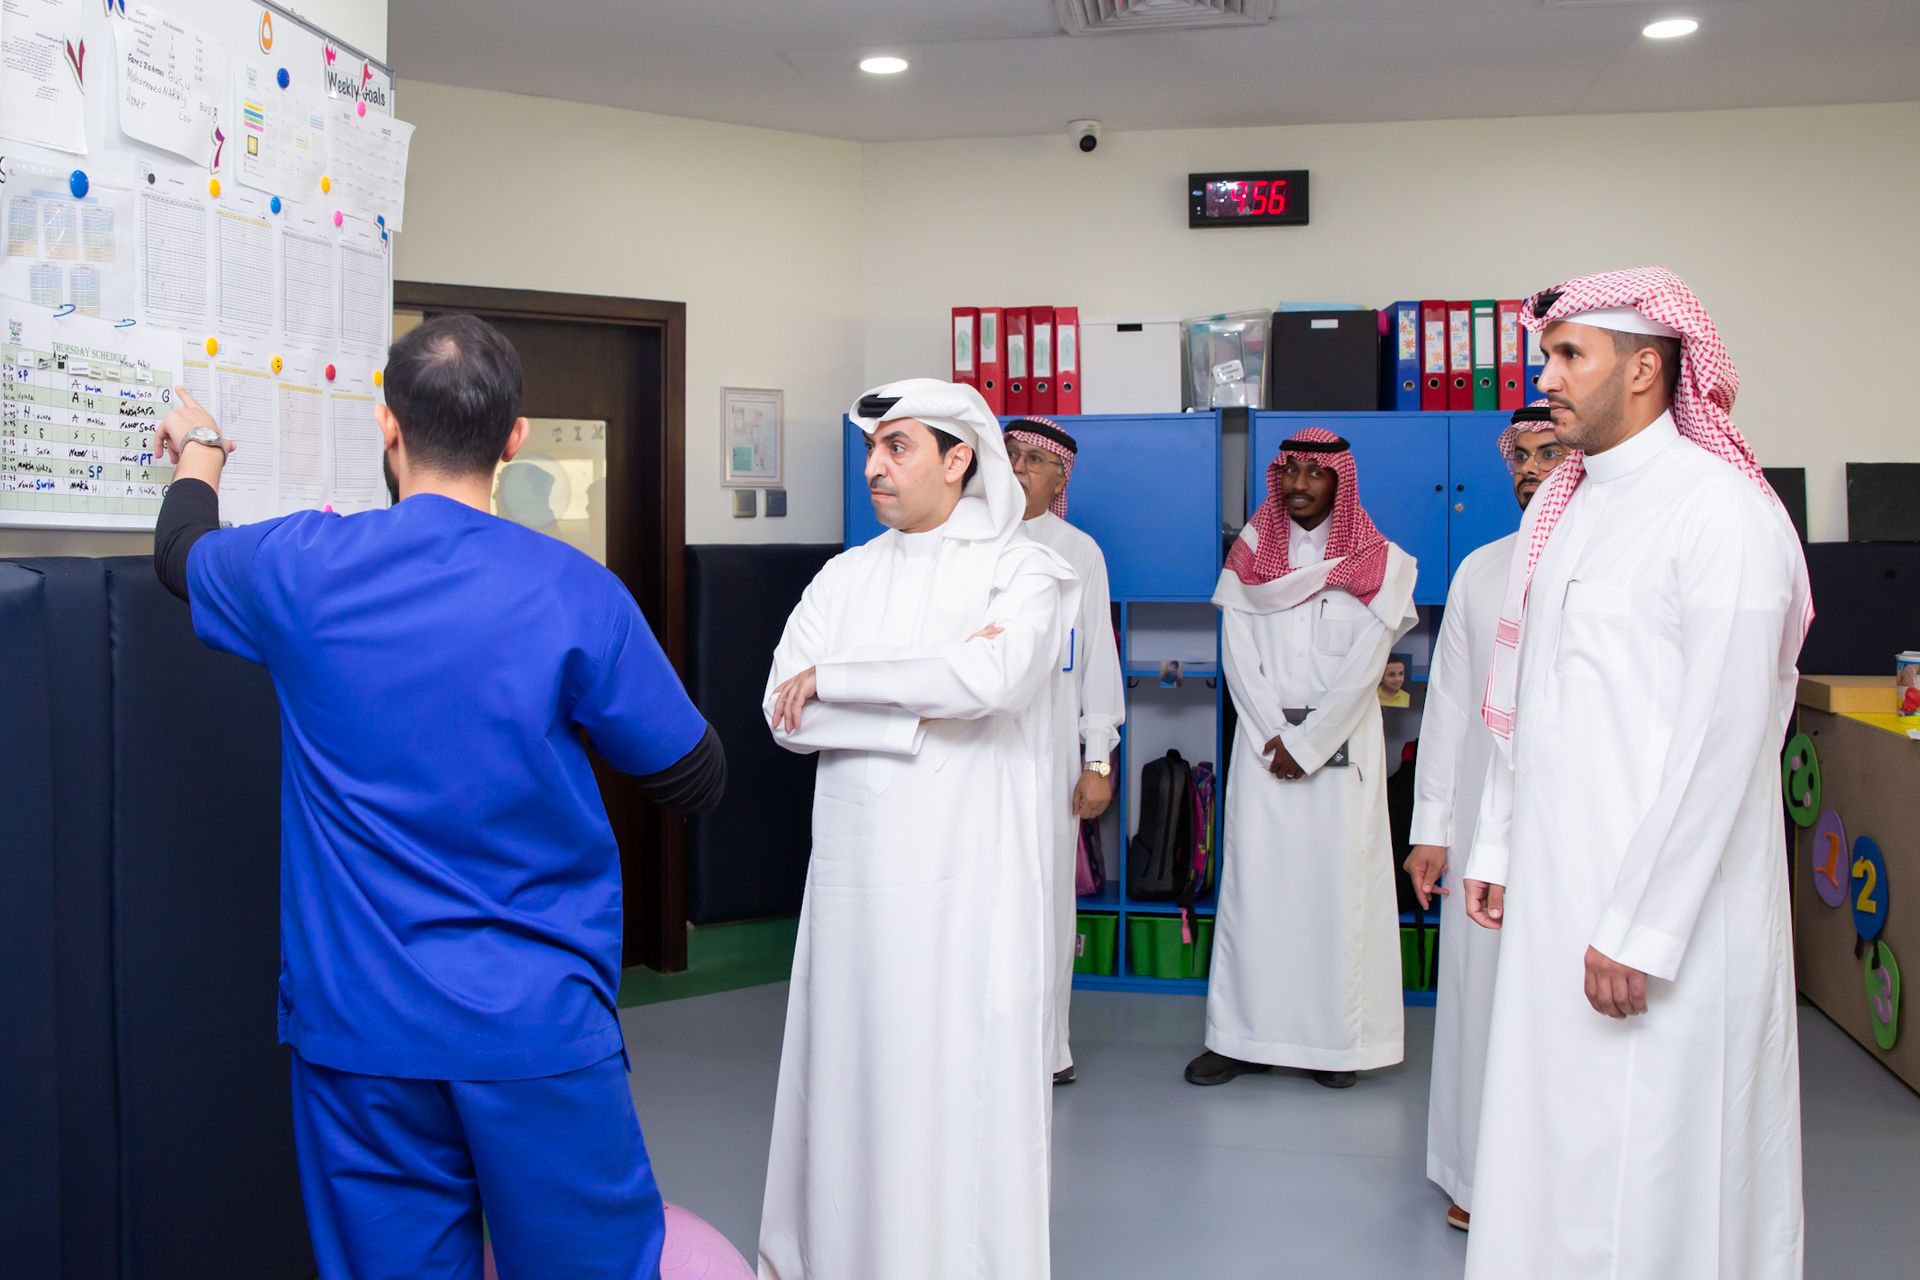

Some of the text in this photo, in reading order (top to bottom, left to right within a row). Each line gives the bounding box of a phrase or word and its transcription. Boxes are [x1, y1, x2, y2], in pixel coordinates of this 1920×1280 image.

[327, 71, 386, 106] Weekly Goals
[72, 391, 79, 403] A
[87, 398, 94, 409] H
[140, 453, 153, 466] PT
[88, 465, 103, 479] SP
[1852, 856, 1877, 913] 2
[1874, 964, 1892, 1024] 3
